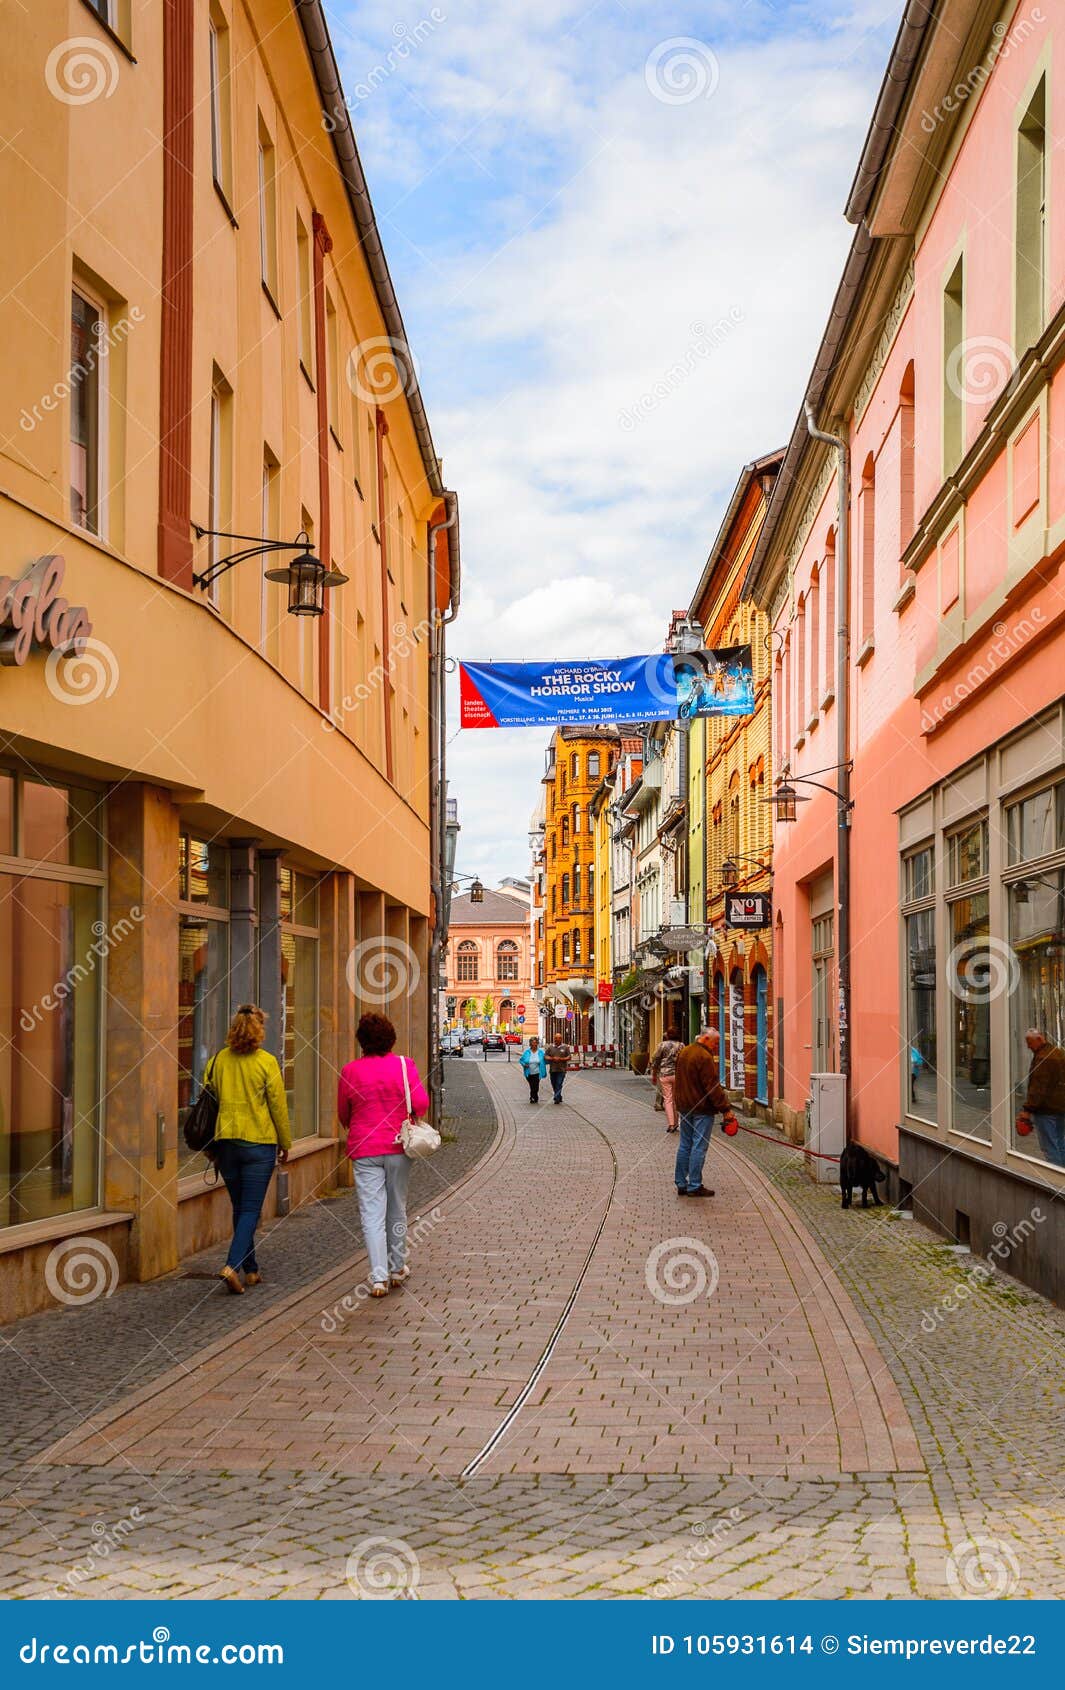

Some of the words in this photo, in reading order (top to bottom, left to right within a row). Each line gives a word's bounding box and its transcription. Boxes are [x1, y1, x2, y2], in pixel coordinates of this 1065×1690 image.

[542, 674, 571, 686] THE
[575, 671, 622, 684] ROCKY
[530, 684, 591, 697] HORROR
[592, 681, 636, 694] SHOW
